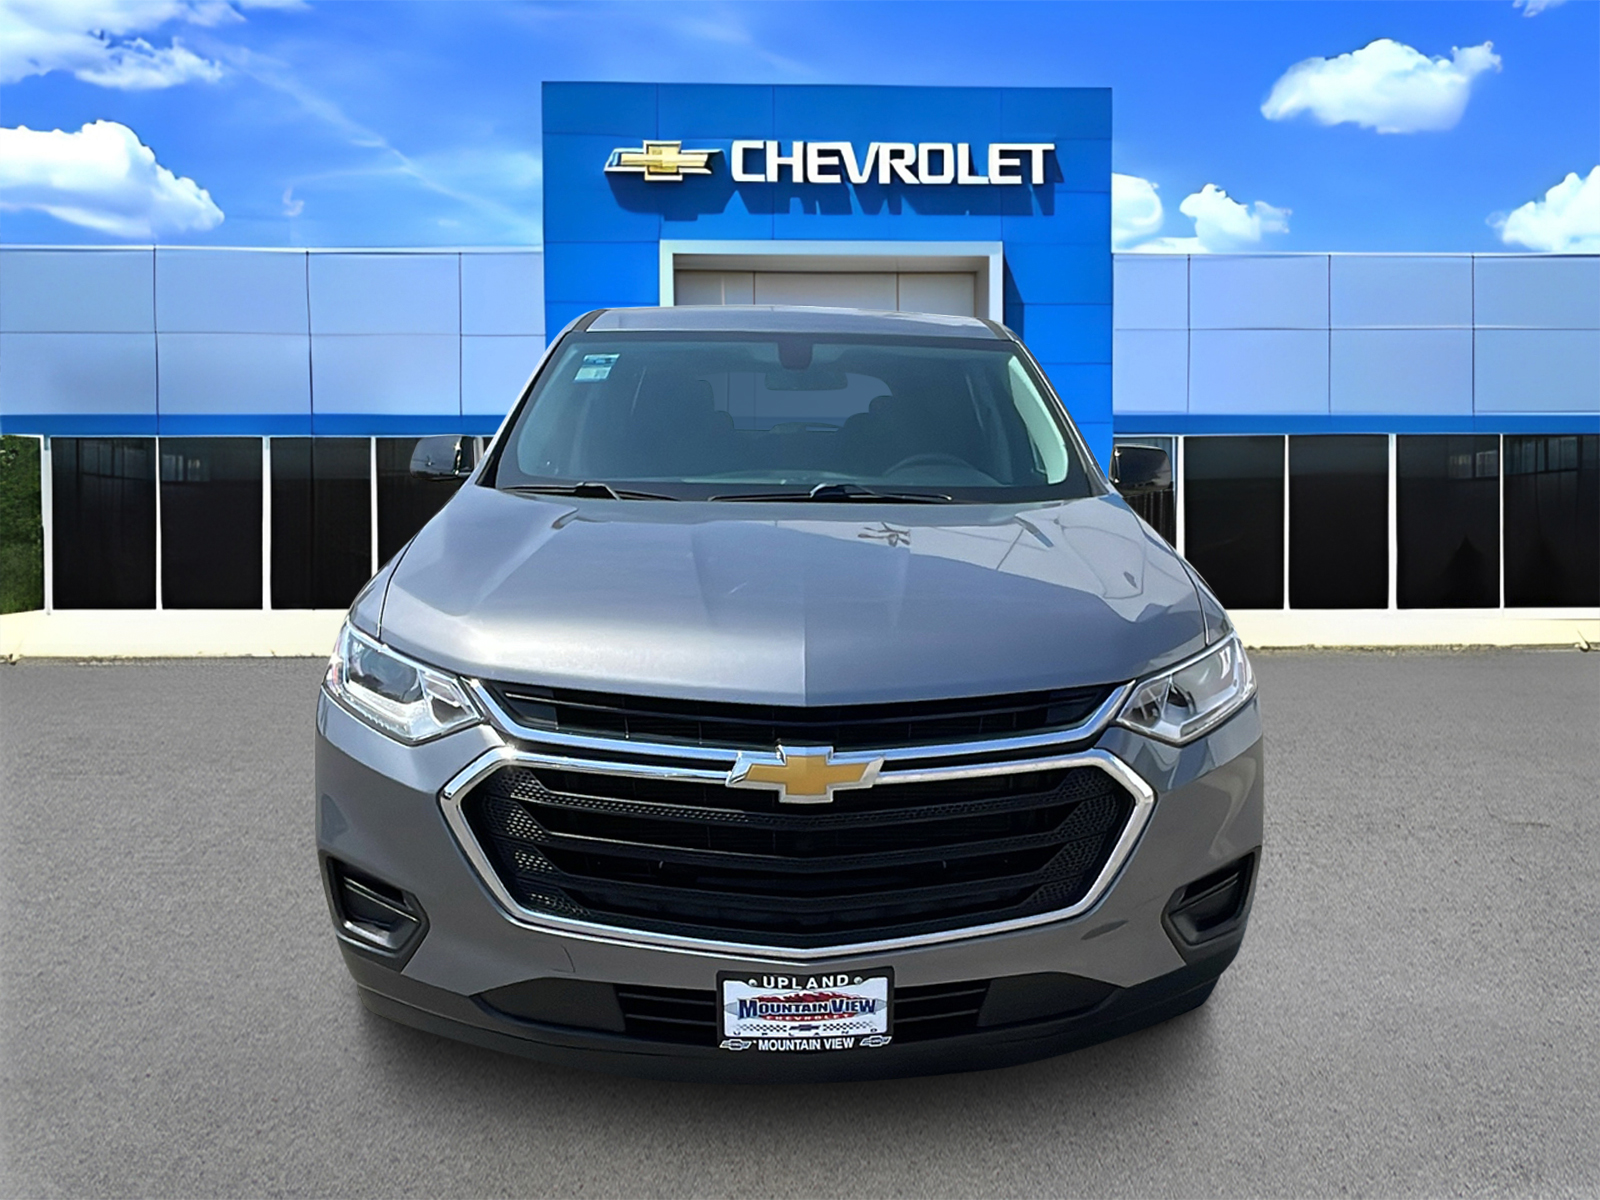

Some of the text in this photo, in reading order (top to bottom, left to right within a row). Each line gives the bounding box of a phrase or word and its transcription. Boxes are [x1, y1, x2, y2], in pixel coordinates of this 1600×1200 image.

[730, 139, 1055, 186] CHEVROLET
[762, 974, 849, 990] UPLAND
[738, 998, 876, 1020] MOUNTAIN VIEW
[758, 1037, 855, 1051] MOUNTAIN VIEW
